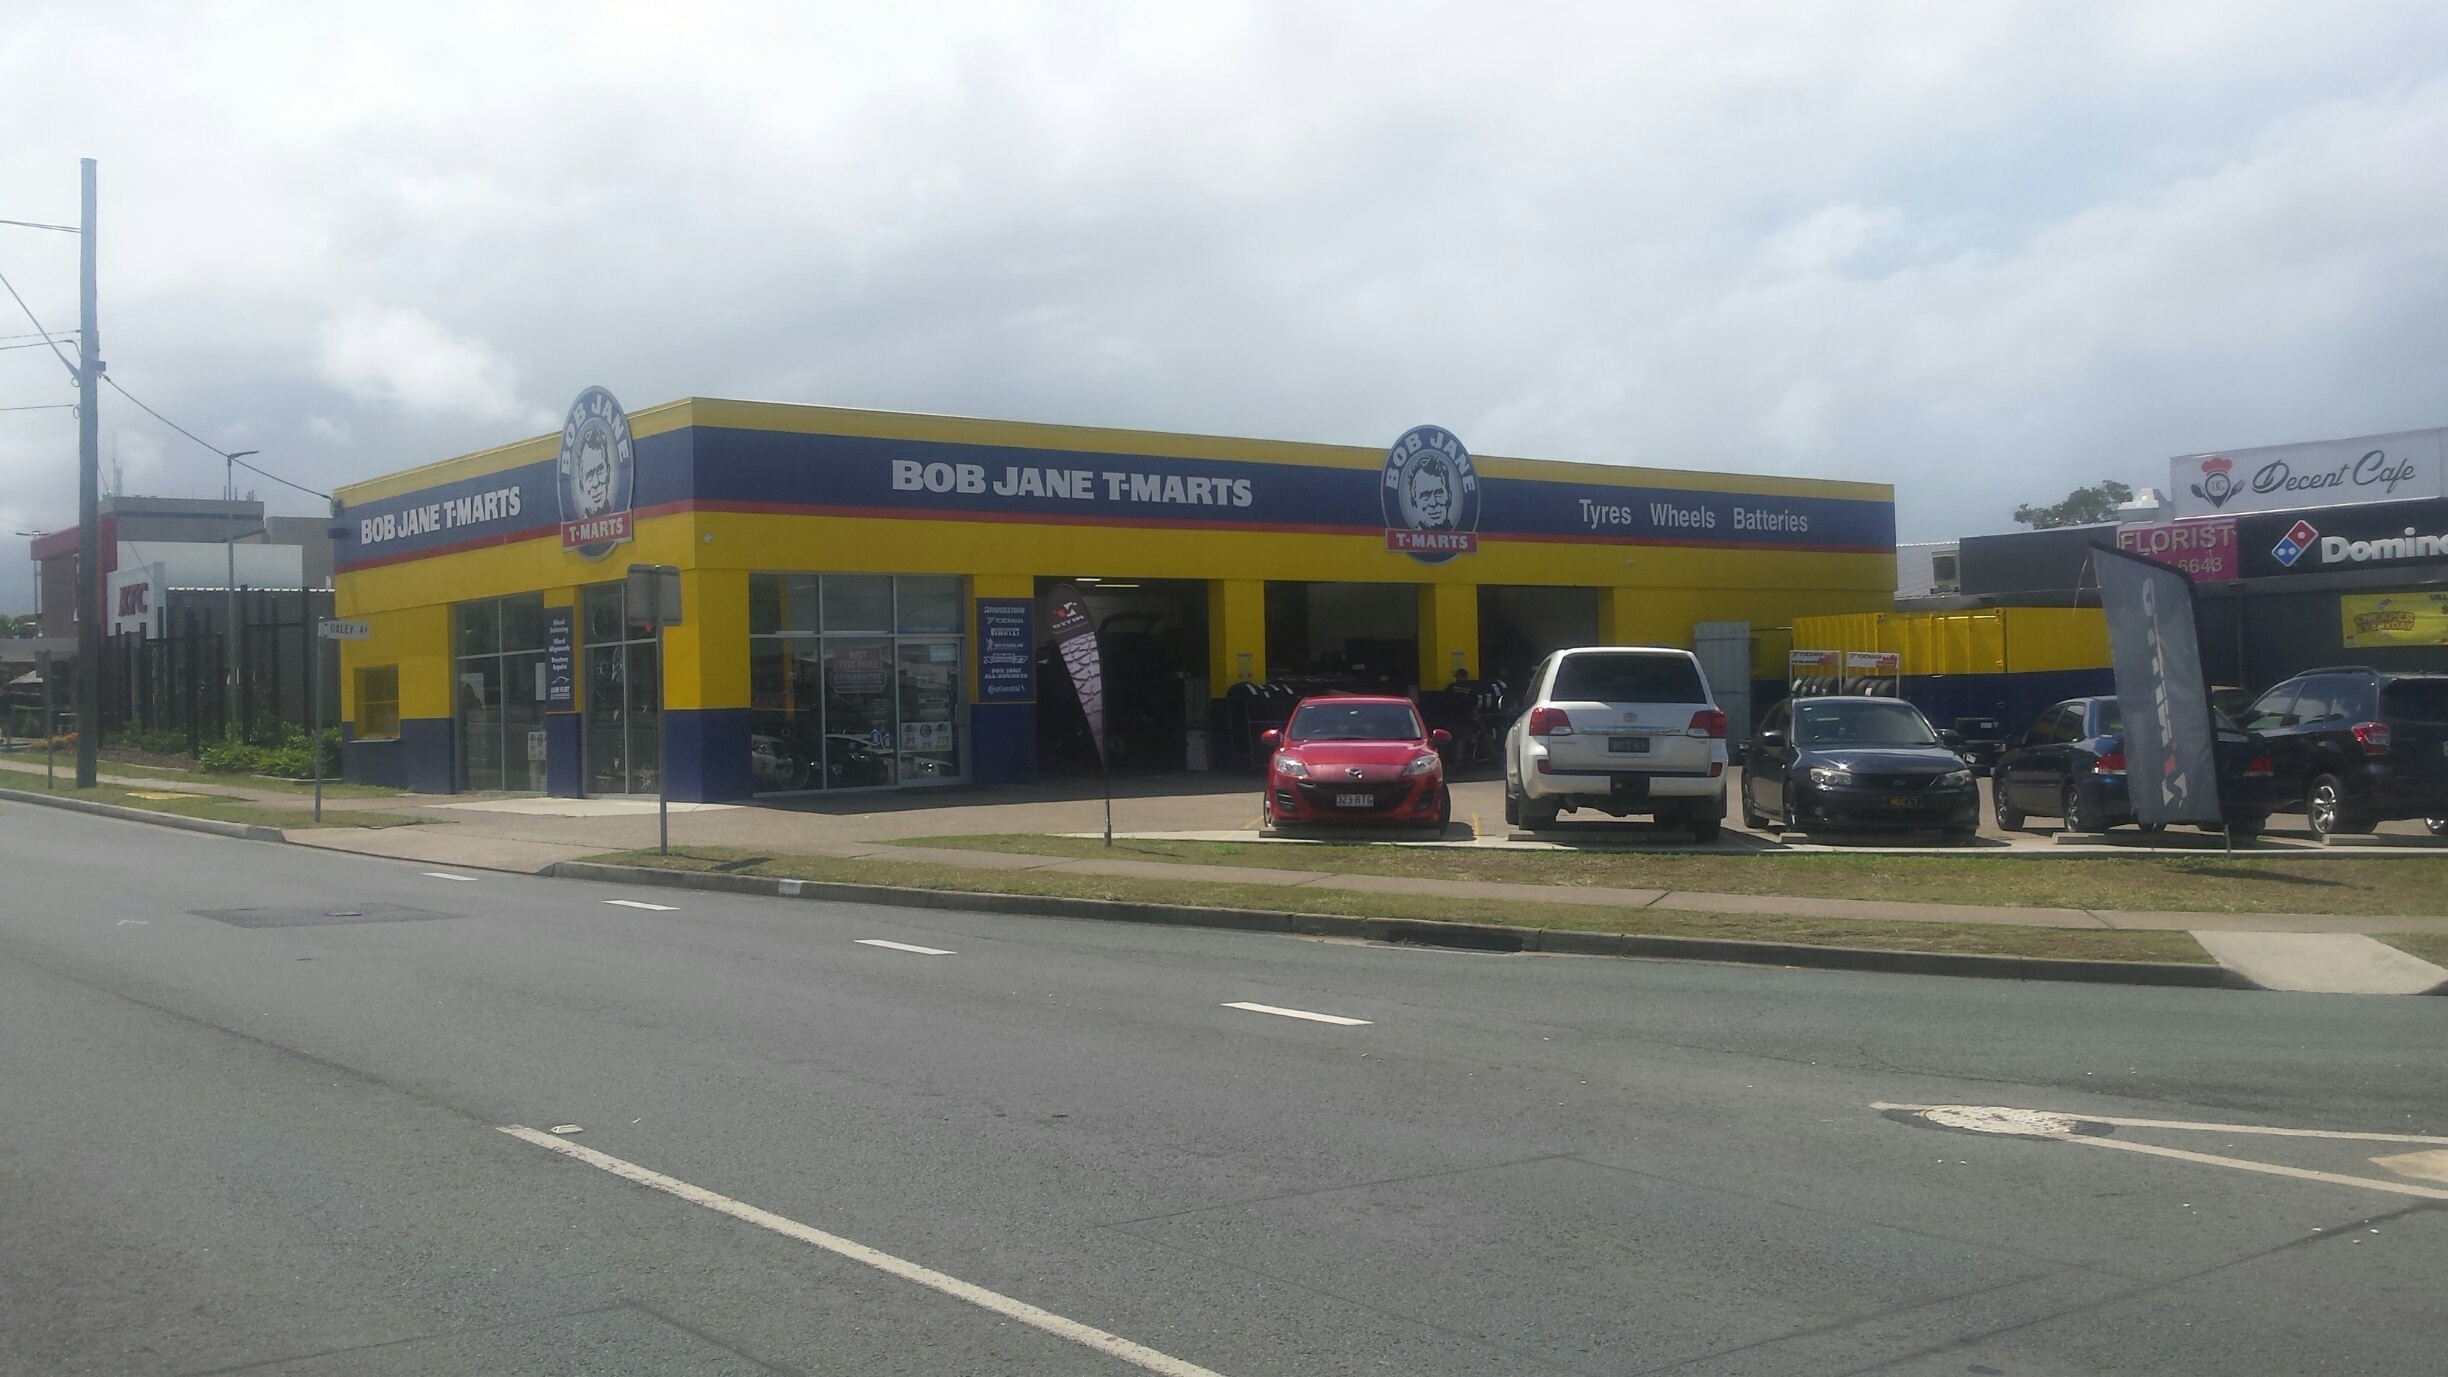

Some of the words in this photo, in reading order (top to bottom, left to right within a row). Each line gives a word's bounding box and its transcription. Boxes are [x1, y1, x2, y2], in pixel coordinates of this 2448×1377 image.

[561, 402, 586, 476] BOB
[591, 394, 630, 463] JANE
[1386, 433, 1422, 490] BOB
[1430, 432, 1475, 493] JANE
[2251, 459, 2350, 494] Decent
[2353, 449, 2416, 494] Cafe
[892, 459, 986, 494] BOB
[993, 466, 1093, 499] JANE
[1102, 472, 1253, 508] T-MARTS
[361, 514, 396, 545] BOB
[397, 504, 440, 538] JANE
[443, 486, 522, 529] T-MARTS
[568, 516, 624, 542] T-MARTS
[1579, 499, 1632, 529] Tyres
[1650, 502, 1716, 528] Wheels
[1733, 507, 1809, 532] Batteries
[1395, 533, 1469, 550] T-MARTS
[2120, 524, 2235, 553] FLORIST
[118, 582, 149, 617] KFC
[984, 606, 1025, 614] BRIDGESTONE
[330, 624, 354, 634] OXLEY
[2355, 611, 2416, 625] CHEAPER
[2357, 621, 2415, 633] EVERYDAY
[833, 673, 883, 685] GUARANTEE
